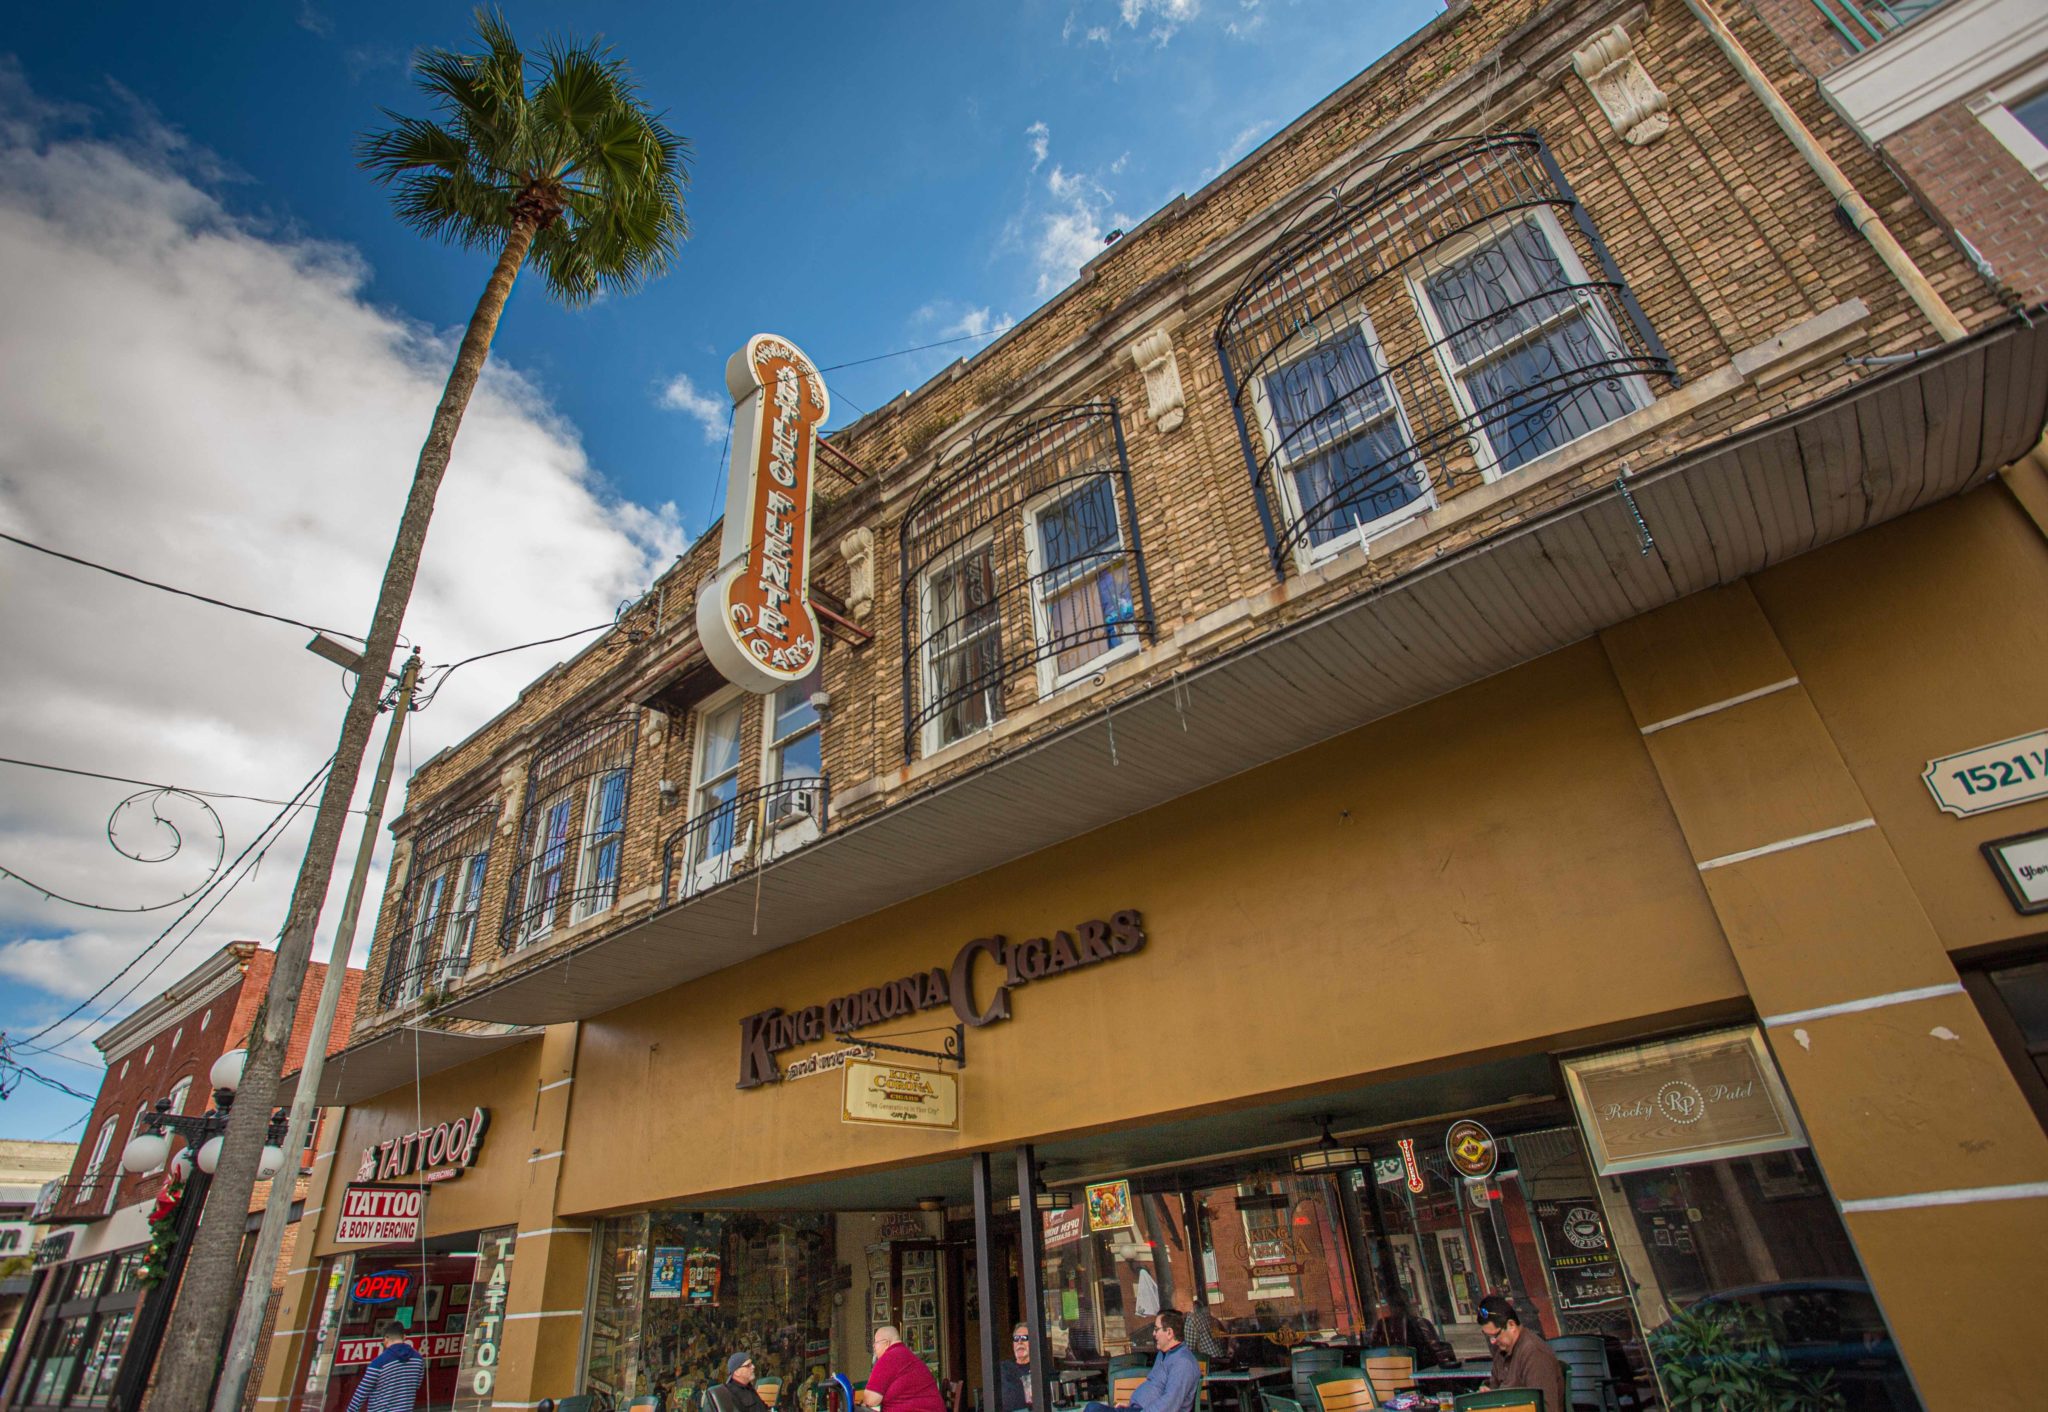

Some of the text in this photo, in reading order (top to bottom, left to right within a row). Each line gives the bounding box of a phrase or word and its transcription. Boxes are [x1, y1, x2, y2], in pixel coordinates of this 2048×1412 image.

[769, 366, 801, 487] ARTURO
[757, 490, 795, 642] FUENTE
[730, 602, 815, 671] CIGARS
[1952, 754, 2036, 796] 1521
[736, 908, 1146, 1090] KING CORONA CIGARS
[874, 1075, 934, 1094] CORONA
[889, 1069, 921, 1081] KING
[1602, 1101, 1653, 1121] Rocky
[1706, 1081, 1753, 1103] Patel
[348, 1190, 421, 1217] TATTOO
[340, 1221, 416, 1239] & BODY PIERCING
[355, 1276, 409, 1298] OPEN
[305, 1263, 343, 1393] PERCING
[473, 1237, 511, 1396] TATTOO
[419, 1339, 430, 1355] &
[434, 1337, 463, 1354] PIE
